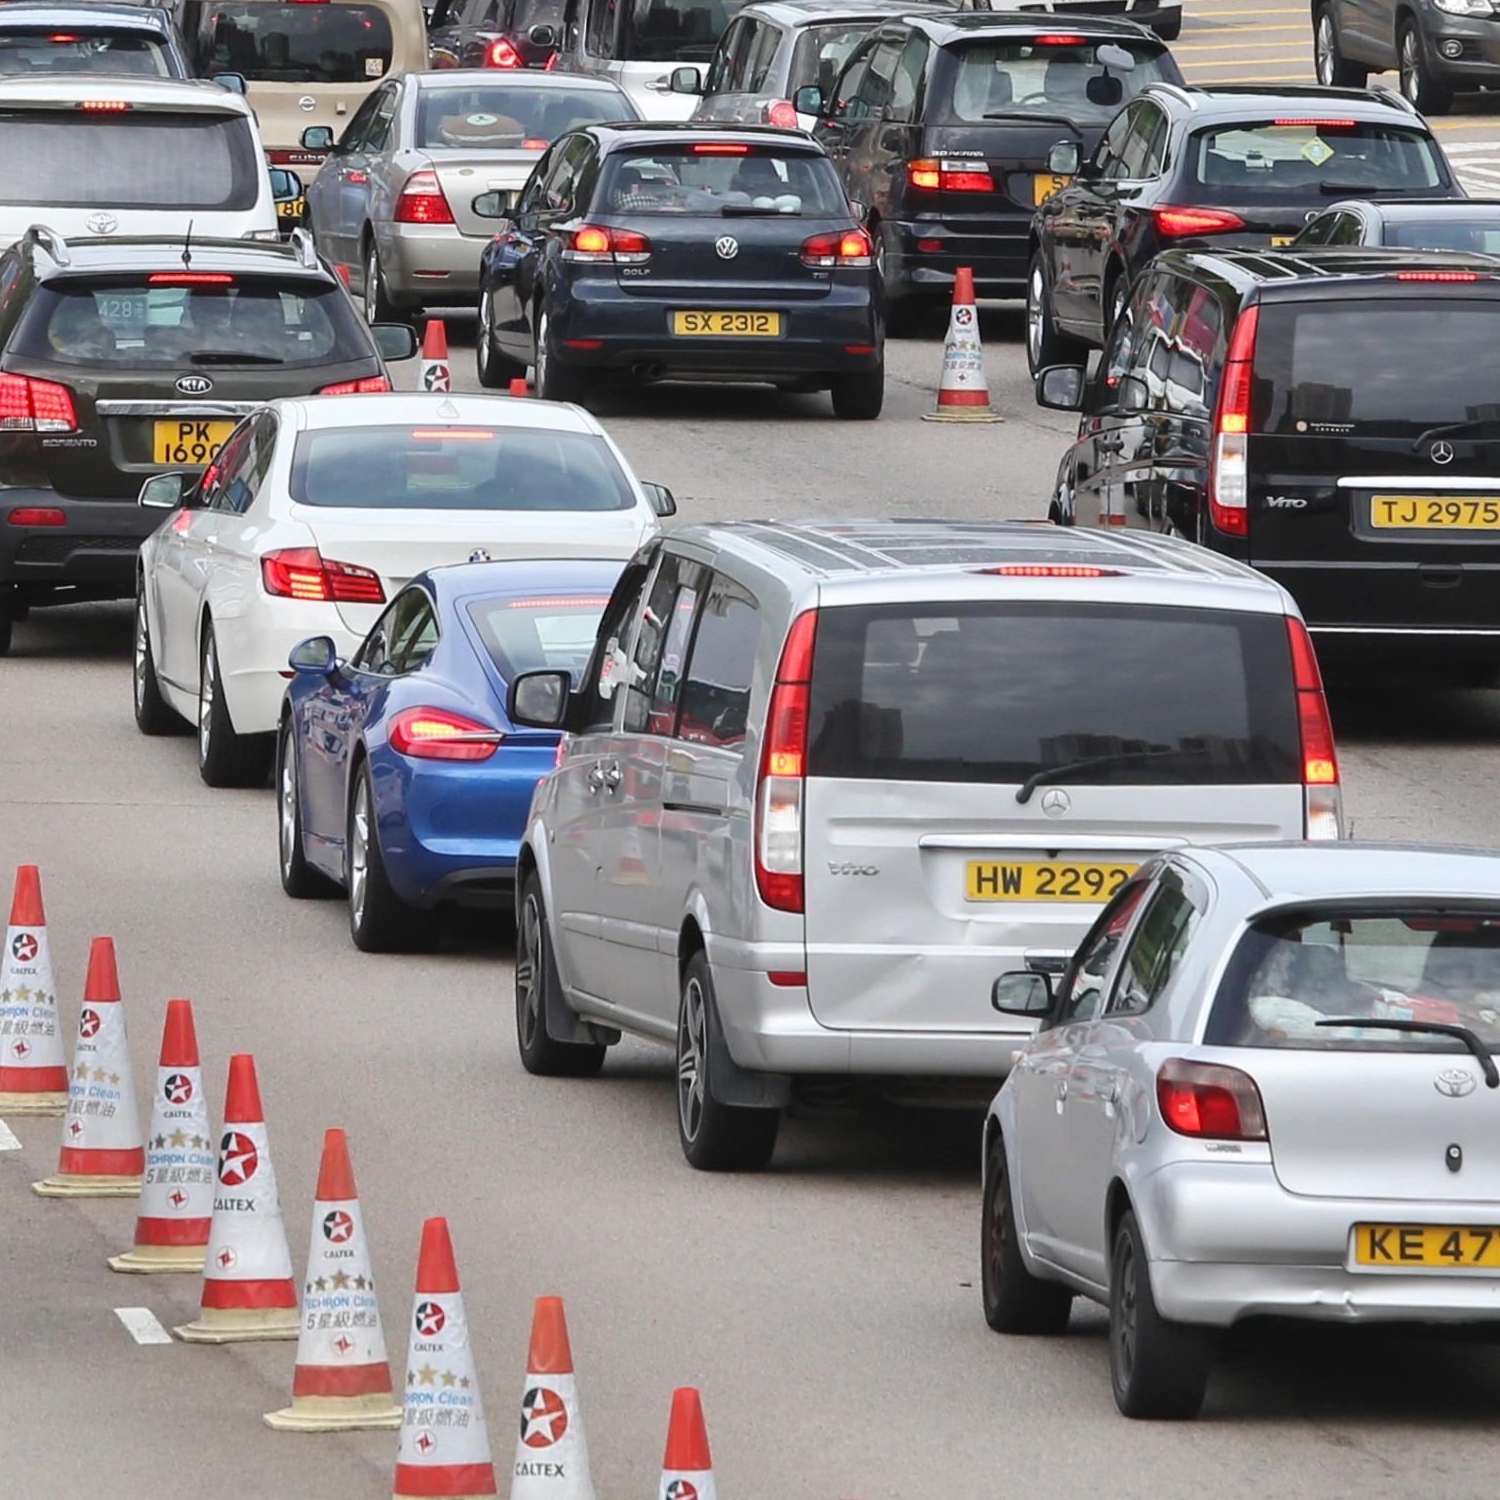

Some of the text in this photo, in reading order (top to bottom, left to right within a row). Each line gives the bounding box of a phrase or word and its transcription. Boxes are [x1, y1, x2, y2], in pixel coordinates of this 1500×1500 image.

[622, 268, 650, 276] GOLF
[99, 301, 133, 318] 428
[684, 314, 769, 333] SX 2312
[182, 379, 207, 391] KIA
[179, 422, 210, 442] PK
[1382, 501, 1500, 524] TJ 2975
[975, 866, 1130, 897] HW 2292
[11, 967, 37, 976] CALTEX
[163, 1110, 193, 1119] CALTEX
[1368, 1227, 1500, 1263] KE 47
[323, 1249, 355, 1259] CALTEX
[413, 1342, 444, 1352] CALTEX
[438, 1392, 473, 1407] Clean
[514, 1461, 566, 1479] CALTEX
